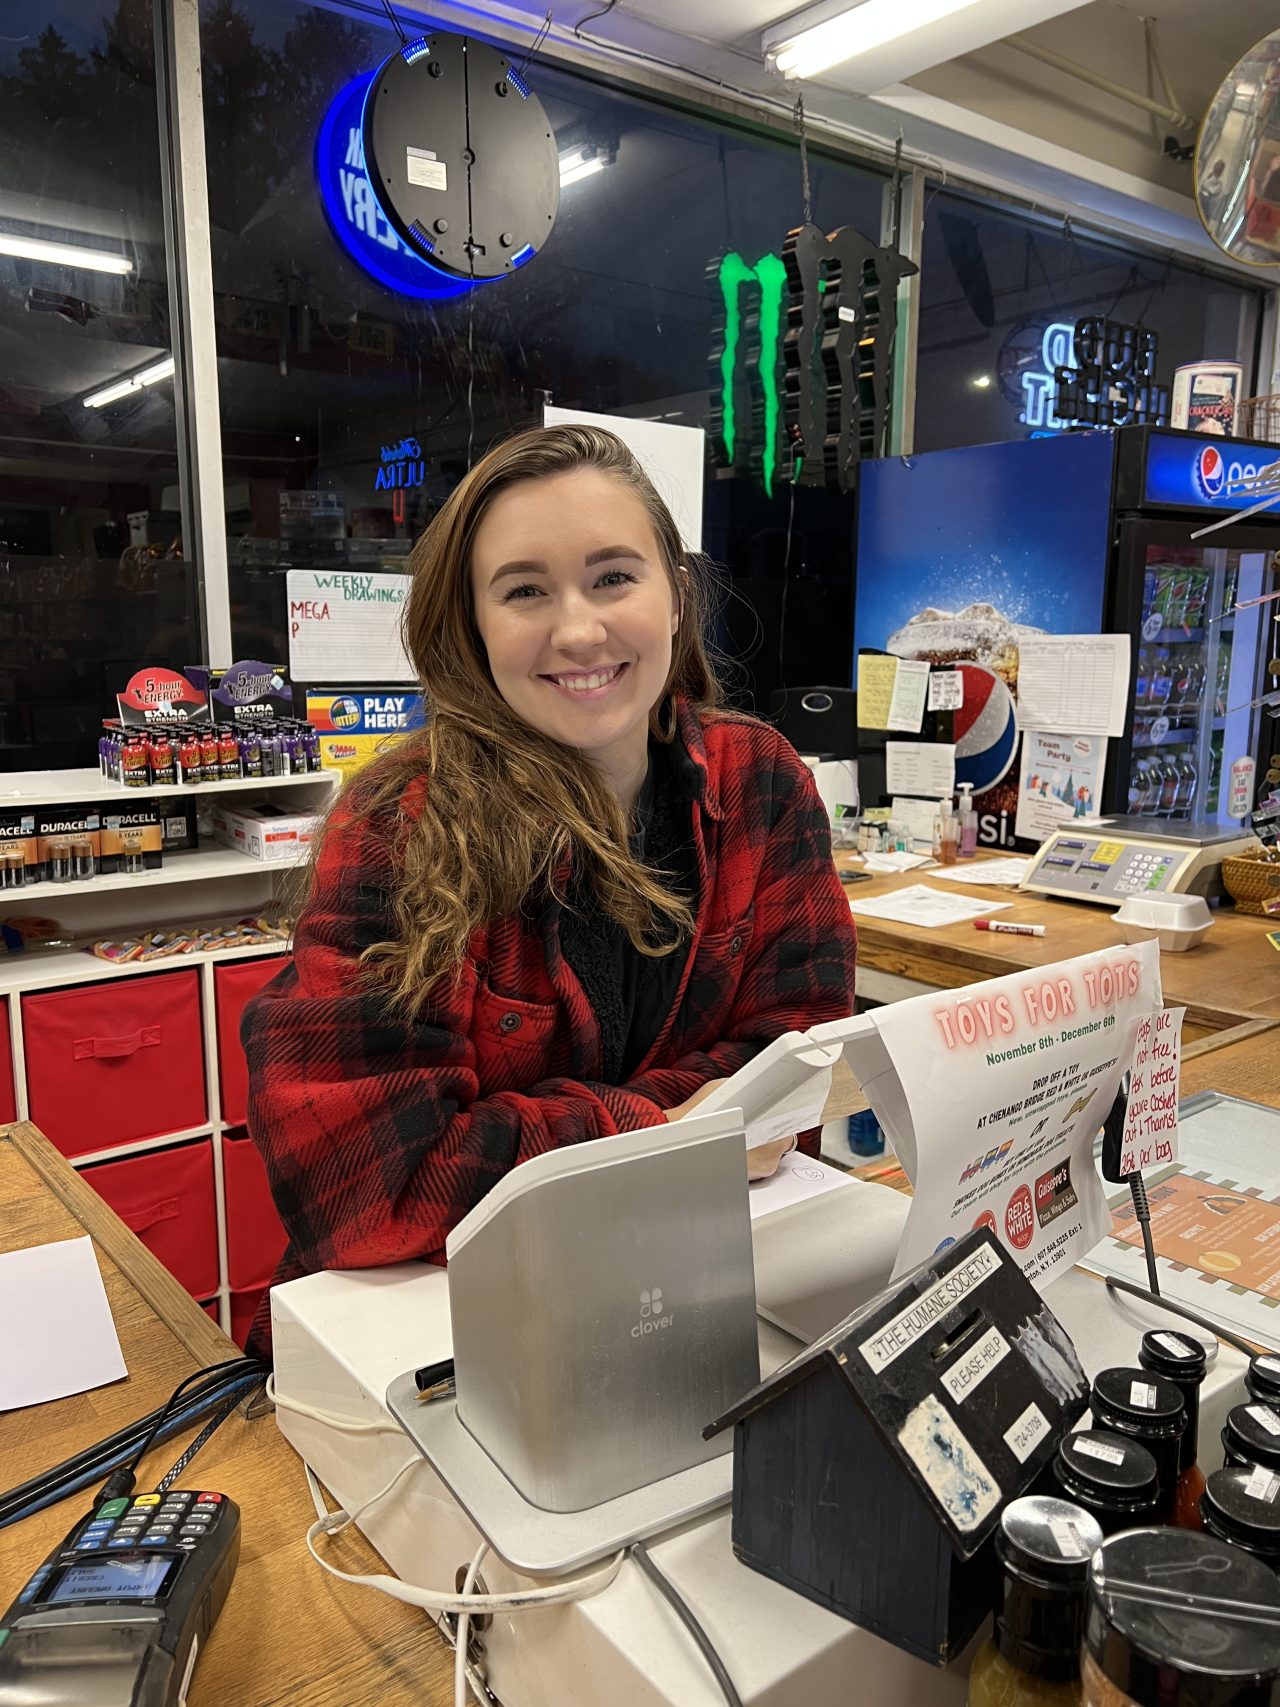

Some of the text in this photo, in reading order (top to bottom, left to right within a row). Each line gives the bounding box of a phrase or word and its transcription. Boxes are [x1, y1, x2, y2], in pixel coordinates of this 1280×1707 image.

[313, 574, 374, 589] WEEKLY
[343, 587, 405, 603] DRAWINGS
[290, 601, 330, 621] MEGA
[291, 621, 300, 638] P
[144, 689, 184, 704] ENERGY
[234, 685, 273, 700] ENERGY
[144, 708, 187, 718] EXTRA
[233, 703, 274, 714] EXTRA
[363, 697, 405, 712] PLAY
[234, 711, 274, 719] STRENGTH
[364, 713, 408, 729] HERE
[1046, 751, 1071, 763] Party
[40, 820, 87, 833] DURACEL
[102, 813, 157, 826] DRACELL
[935, 959, 1140, 1050] TOYS FOR TOTS
[1156, 1013, 1171, 1033] are
[986, 1042, 1037, 1066] November
[1039, 1034, 1054, 1050] 8th
[1061, 1021, 1102, 1043] December
[1103, 1014, 1116, 1028] 6th
[1136, 1044, 1149, 1067] not
[1032, 1062, 1081, 1091] DROP OFF A TOY
[1131, 1063, 1177, 1095] Ask before
[977, 1116, 988, 1130] AT
[988, 1100, 1023, 1125] CHENANGO
[1023, 1091, 1046, 1109] BRIDGE
[1045, 1085, 1058, 1100] RED
[1063, 1074, 1082, 1090] WHITE
[1139, 1144, 1152, 1169] per
[1154, 1138, 1174, 1163] bag
[1037, 1167, 1068, 1199] Guiseppe's
[1007, 1204, 1024, 1225] RED
[1023, 1196, 1031, 1210] &
[1007, 1213, 1033, 1238] WHITE
[1051, 1248, 1066, 1264] 13901
[877, 1258, 988, 1356] THE HUMANE SOCIETY
[631, 1314, 674, 1338] clover
[950, 1335, 1002, 1394] PLEASE HELP
